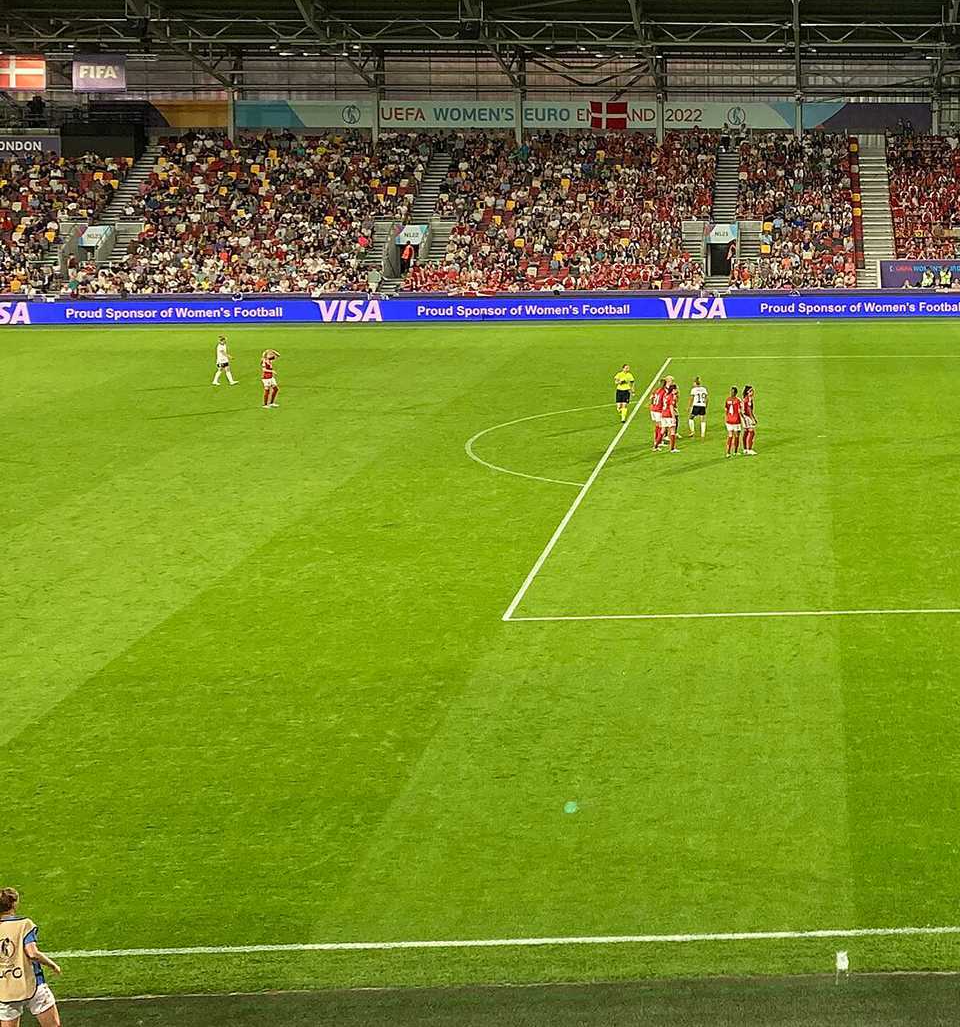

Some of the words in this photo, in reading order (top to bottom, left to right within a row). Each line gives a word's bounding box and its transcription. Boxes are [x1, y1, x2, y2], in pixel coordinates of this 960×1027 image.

[79, 65, 118, 79] FIFA
[381, 107, 425, 121] UEFA
[433, 107, 514, 122] WOMEN'S
[525, 108, 570, 122] EURO
[577, 108, 656, 122] EAND
[665, 108, 702, 122] 2022
[65, 308, 103, 319] Proud
[106, 307, 158, 321] Sponsor
[160, 307, 174, 318] of
[175, 307, 231, 318] Women's
[234, 306, 283, 318] Football
[313, 300, 383, 322] VISA
[417, 305, 454, 316] Proud
[456, 305, 508, 319] Sponsor
[510, 305, 523, 316] of
[525, 305, 580, 316] Women's
[582, 304, 630, 315] Football
[659, 297, 727, 319] VISA
[760, 302, 795, 313] Proud
[798, 302, 847, 316] Sponsor
[849, 302, 862, 313] of
[864, 302, 916, 313] Women's
